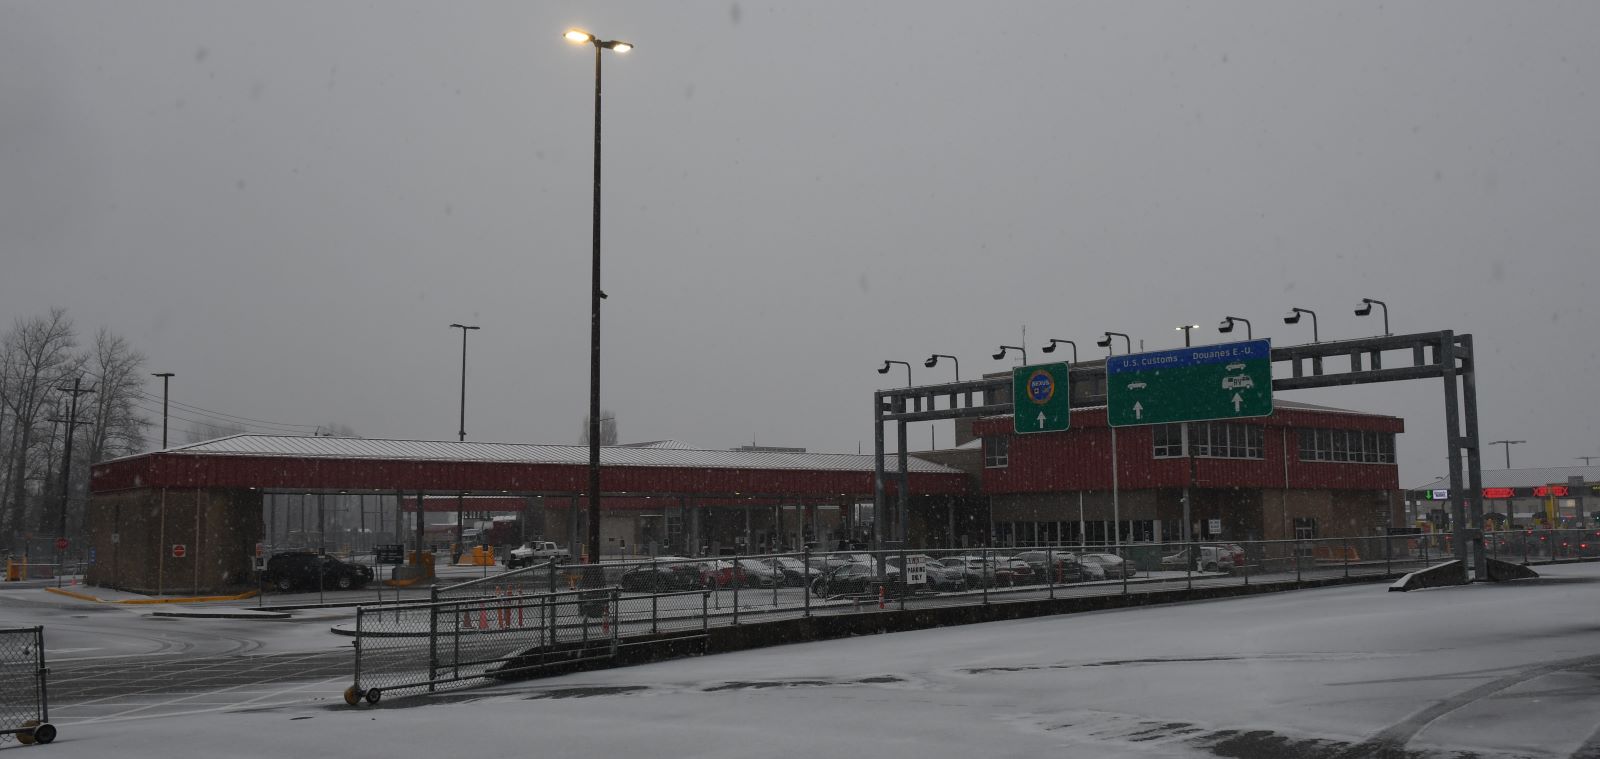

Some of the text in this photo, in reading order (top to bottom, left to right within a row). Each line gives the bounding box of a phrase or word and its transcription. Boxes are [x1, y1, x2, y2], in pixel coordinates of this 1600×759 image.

[1141, 355, 1178, 366] Customs
[1192, 349, 1231, 361] Douanes
[907, 566, 925, 574] PARKING
